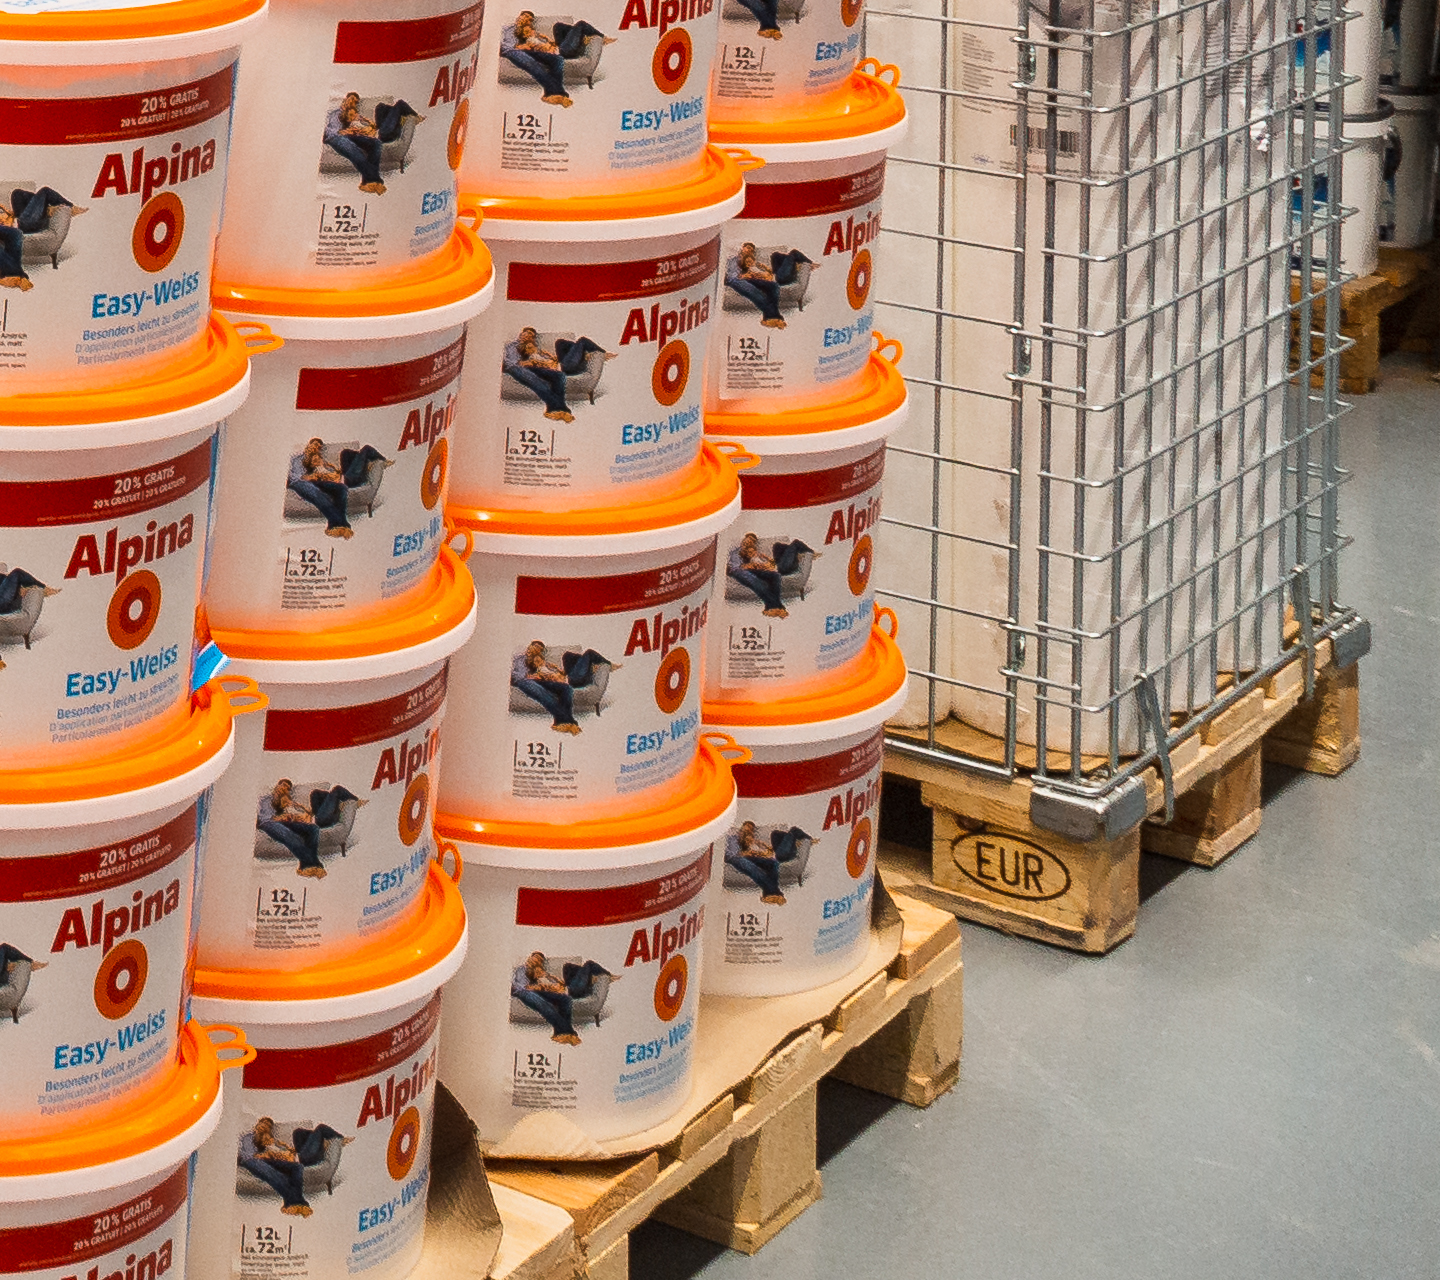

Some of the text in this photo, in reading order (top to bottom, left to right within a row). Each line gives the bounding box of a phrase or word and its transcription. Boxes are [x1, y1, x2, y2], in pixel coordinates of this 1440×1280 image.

[141, 87, 200, 114] 20% GRATIS
[90, 138, 216, 208] Alpina
[91, 270, 201, 321] Easy-Weiss
[63, 512, 194, 588] Alpina
[973, 841, 1047, 897] EUR
